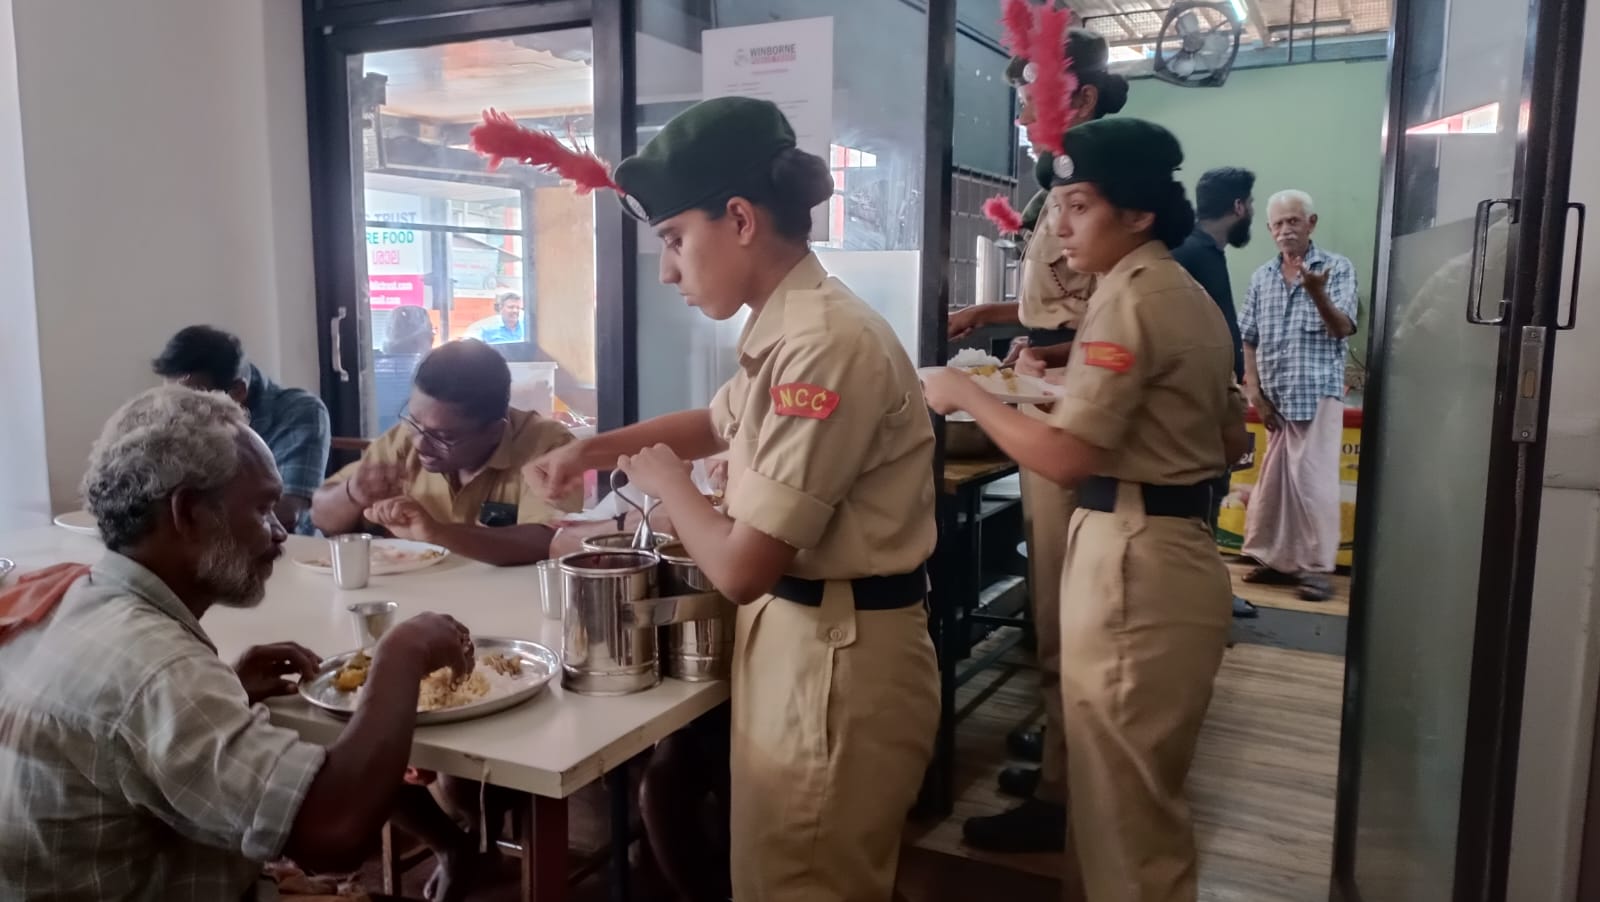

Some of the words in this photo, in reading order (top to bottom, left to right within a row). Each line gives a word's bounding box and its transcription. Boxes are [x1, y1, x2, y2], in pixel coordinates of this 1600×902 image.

[749, 44, 796, 57] WINBORNE
[374, 212, 416, 225] TRUST
[383, 230, 414, 245] FOOD
[780, 387, 827, 411] NCC
